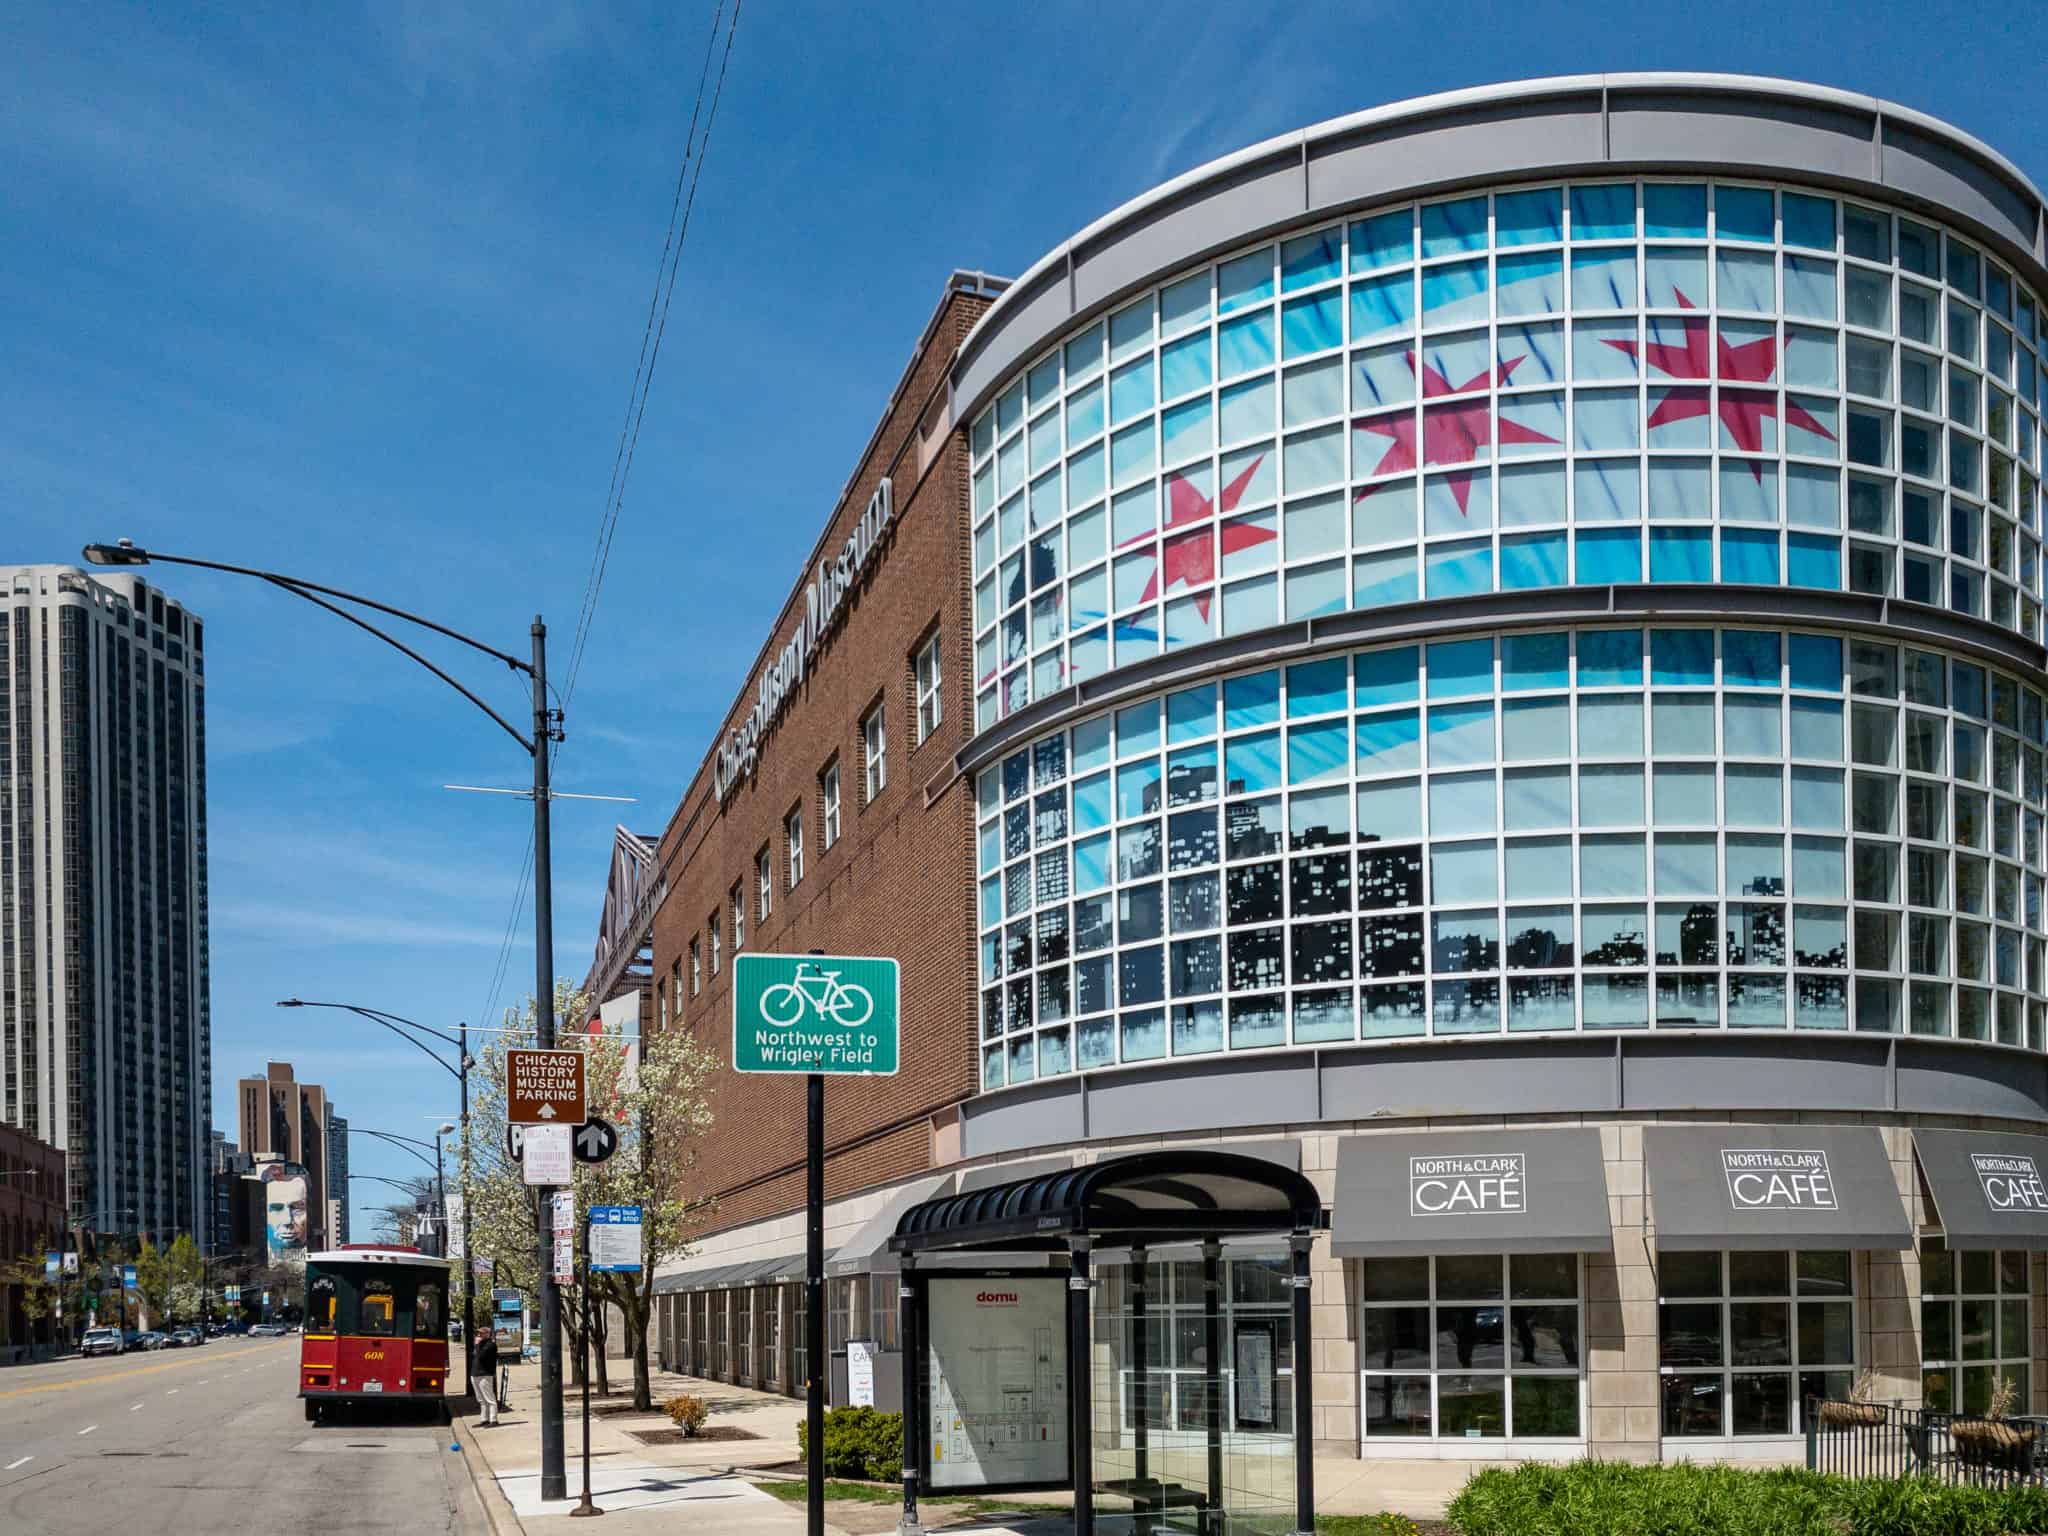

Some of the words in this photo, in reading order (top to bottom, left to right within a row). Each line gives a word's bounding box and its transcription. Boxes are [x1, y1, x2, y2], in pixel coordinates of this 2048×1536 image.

[714, 703, 761, 801] Chicago
[759, 614, 806, 733] History
[805, 476, 894, 657] Museum
[755, 1030, 852, 1046] Northwest
[860, 1032, 878, 1048] to
[515, 1055, 576, 1066] CHICAGO
[761, 1047, 824, 1066] Wrigley
[831, 1048, 873, 1063] Field
[516, 1066, 576, 1078] HISTORY
[516, 1078, 576, 1089] MUSEUM
[516, 1089, 577, 1101] PARKING
[1415, 1171, 1521, 1211] CAFÉ
[1734, 1167, 1833, 1204] CAFÉ
[1986, 1173, 2048, 1207] CAFÉ
[622, 1216, 641, 1224] stop
[976, 1291, 1018, 1302] domu
[364, 1351, 384, 1361] 608
